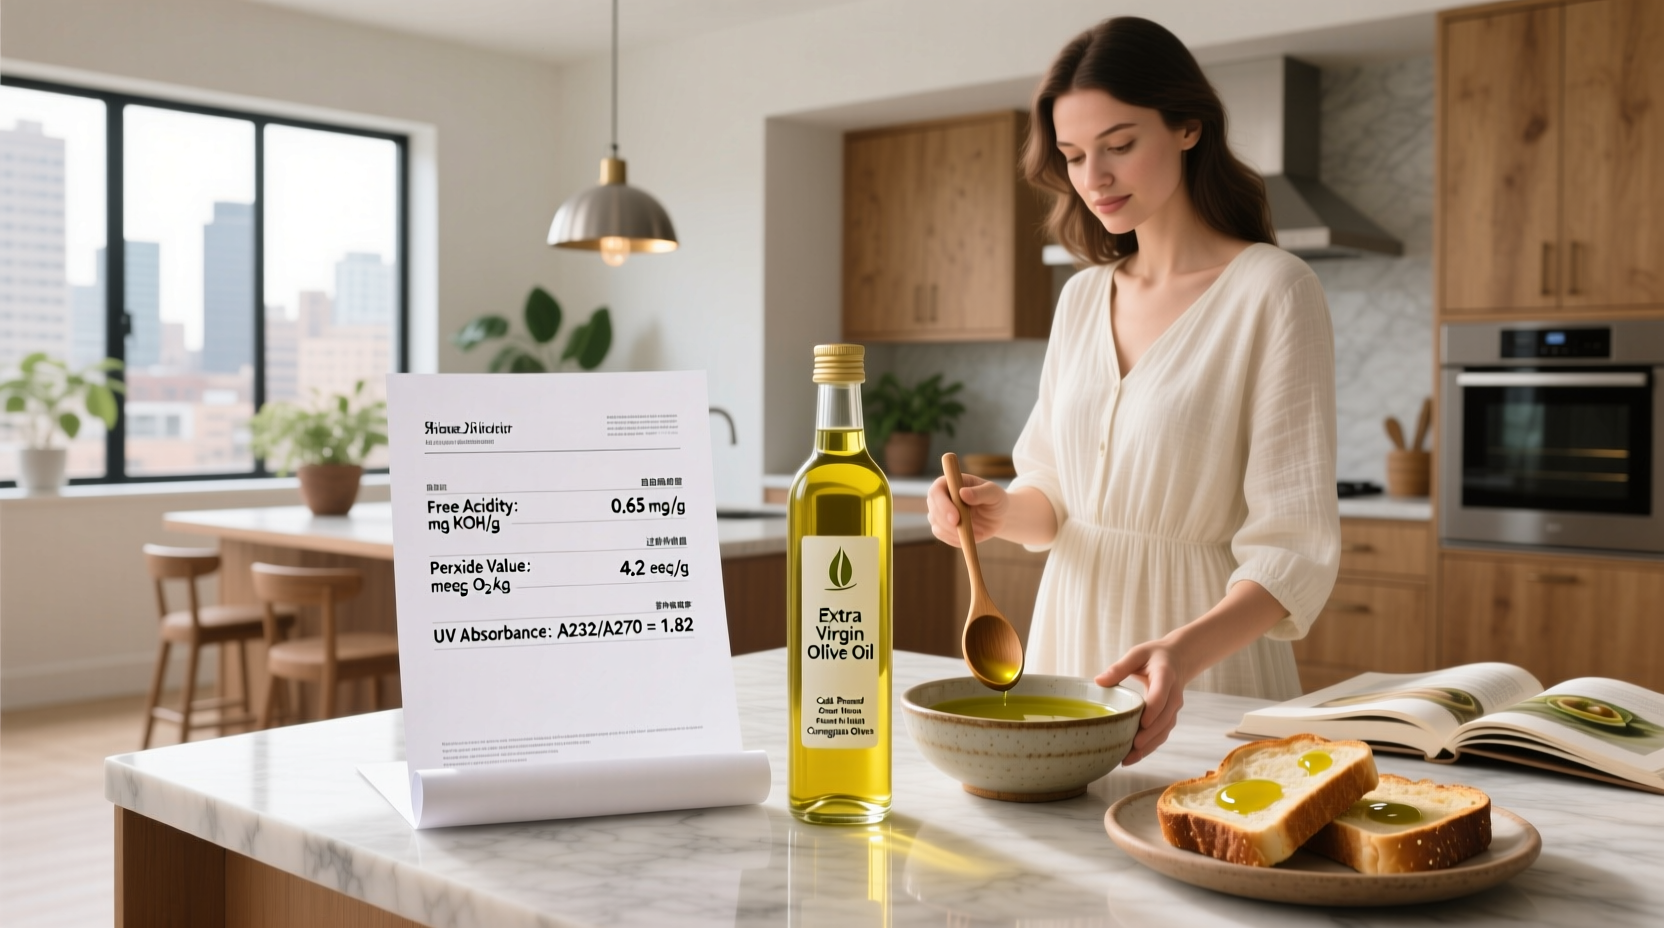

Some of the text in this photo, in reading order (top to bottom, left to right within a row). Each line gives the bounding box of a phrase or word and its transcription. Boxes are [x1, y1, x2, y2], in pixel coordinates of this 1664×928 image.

[428, 497, 518, 517] Free Acidity:
[611, 494, 686, 517] 0.65 mg/g
[428, 514, 501, 534] mg KOH/g
[430, 558, 531, 575] Perxide Value:
[619, 559, 646, 577] 4.2
[819, 607, 862, 623] Extra
[433, 616, 694, 643] UV Absorbance: A232/A270 = 1.82
[815, 625, 865, 646] Virgin
[807, 643, 874, 660] Olive Oil
